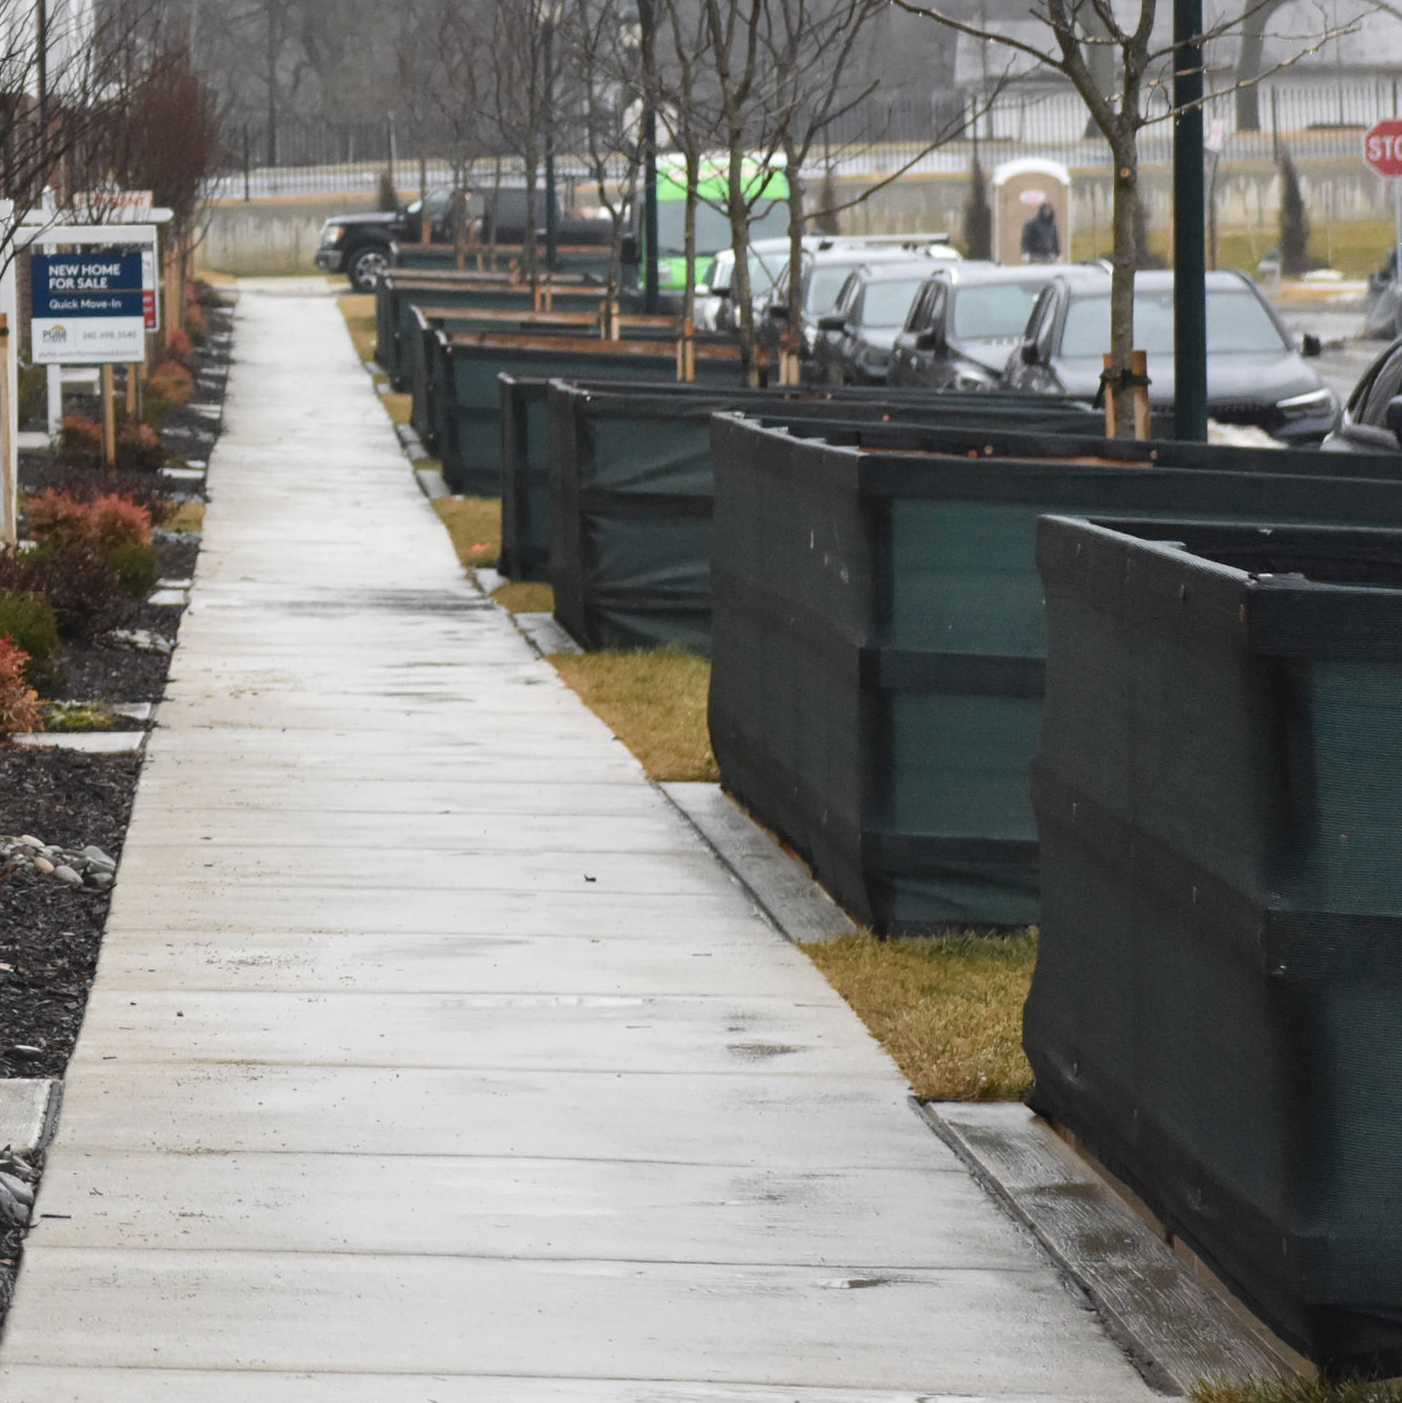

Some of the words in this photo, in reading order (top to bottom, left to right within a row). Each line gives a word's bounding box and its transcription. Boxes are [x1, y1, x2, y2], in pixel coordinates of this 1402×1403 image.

[1369, 135, 1402, 161] STO
[48, 264, 79, 277] NEW
[81, 263, 121, 276] HOME
[49, 277, 75, 289] FOR
[77, 277, 108, 289] SALE
[49, 299, 78, 310] Quick
[80, 298, 122, 309] Move-In
